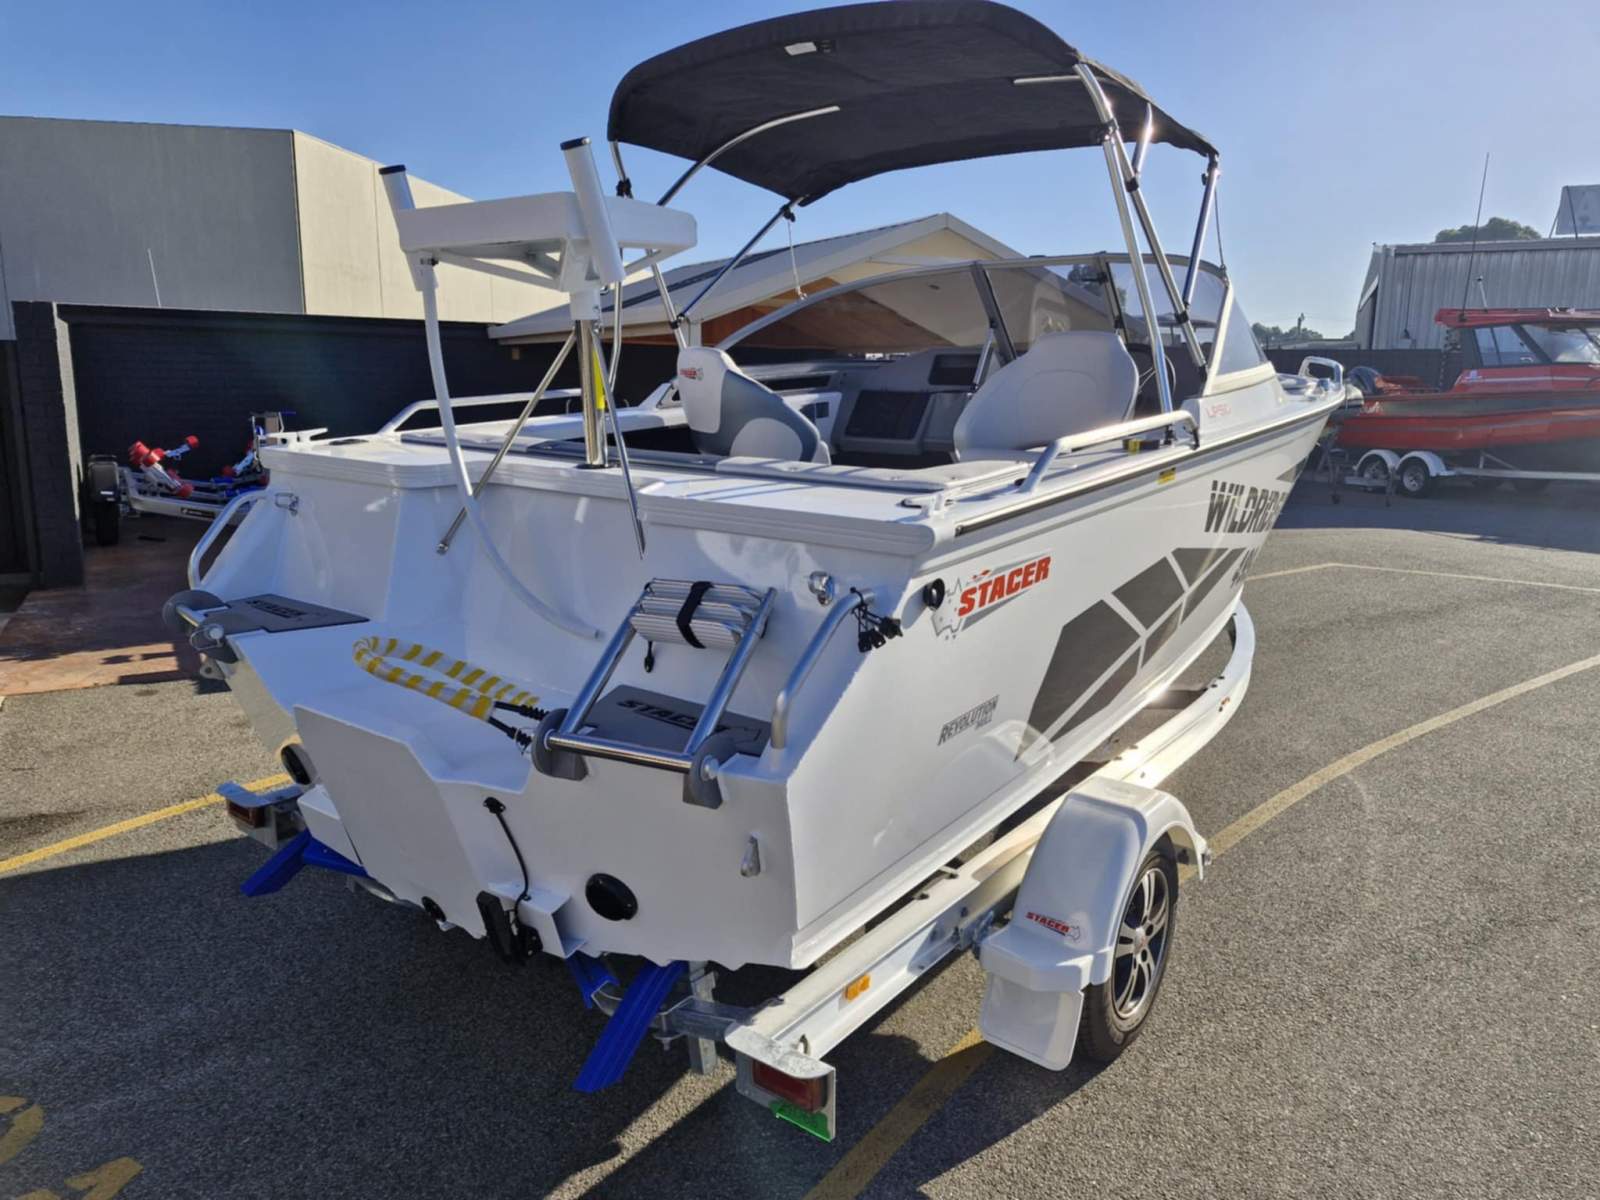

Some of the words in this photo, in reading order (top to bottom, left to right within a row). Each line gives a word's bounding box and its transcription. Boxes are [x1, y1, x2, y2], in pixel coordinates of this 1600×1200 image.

[958, 556, 1051, 617] STACER
[617, 700, 731, 733] STAC
[1026, 911, 1070, 933] STACER
